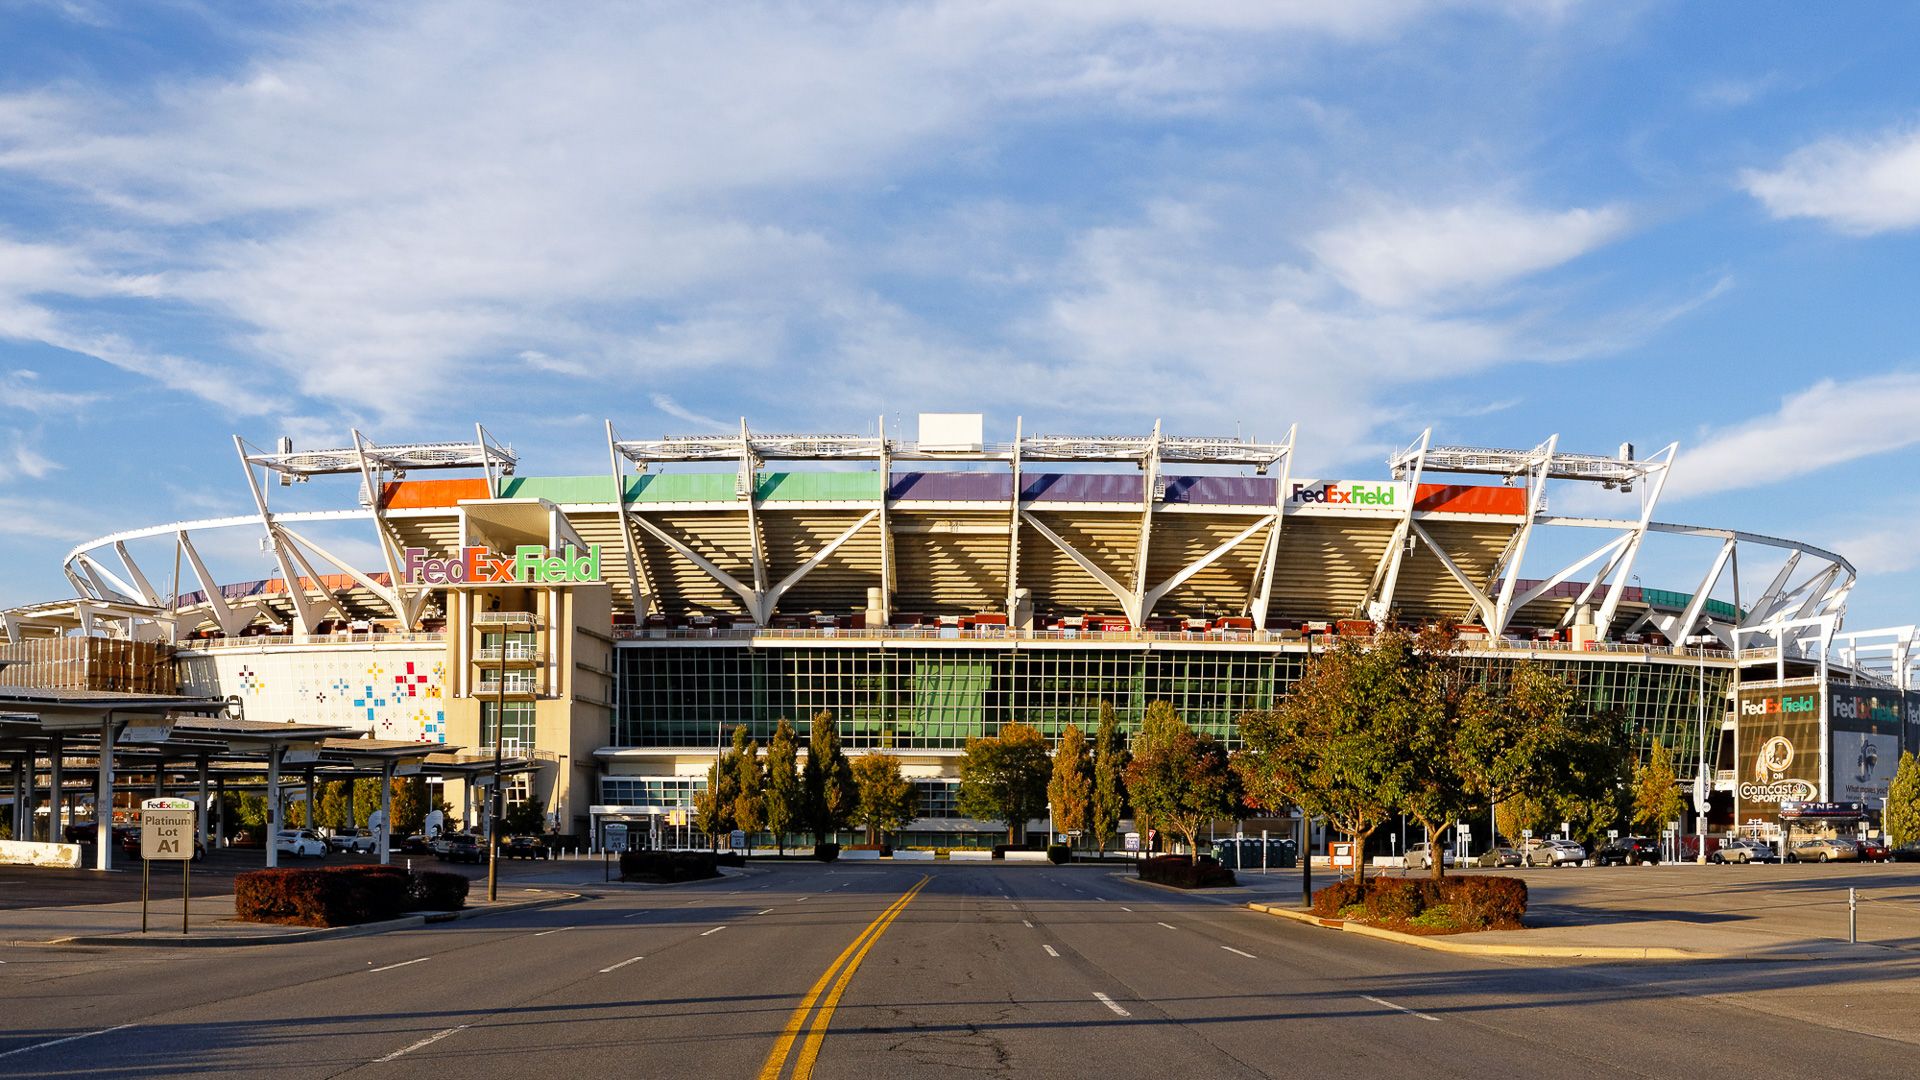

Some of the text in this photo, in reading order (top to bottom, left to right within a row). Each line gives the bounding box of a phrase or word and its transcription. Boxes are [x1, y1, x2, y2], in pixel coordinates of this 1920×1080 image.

[1293, 484, 1394, 505] FedExField
[405, 544, 601, 584] FedExField
[1742, 696, 1814, 715] FedExField
[147, 801, 189, 809] FedExField
[145, 816, 191, 826] Platinum
[158, 828, 178, 836] Lot
[157, 840, 179, 853] A1
